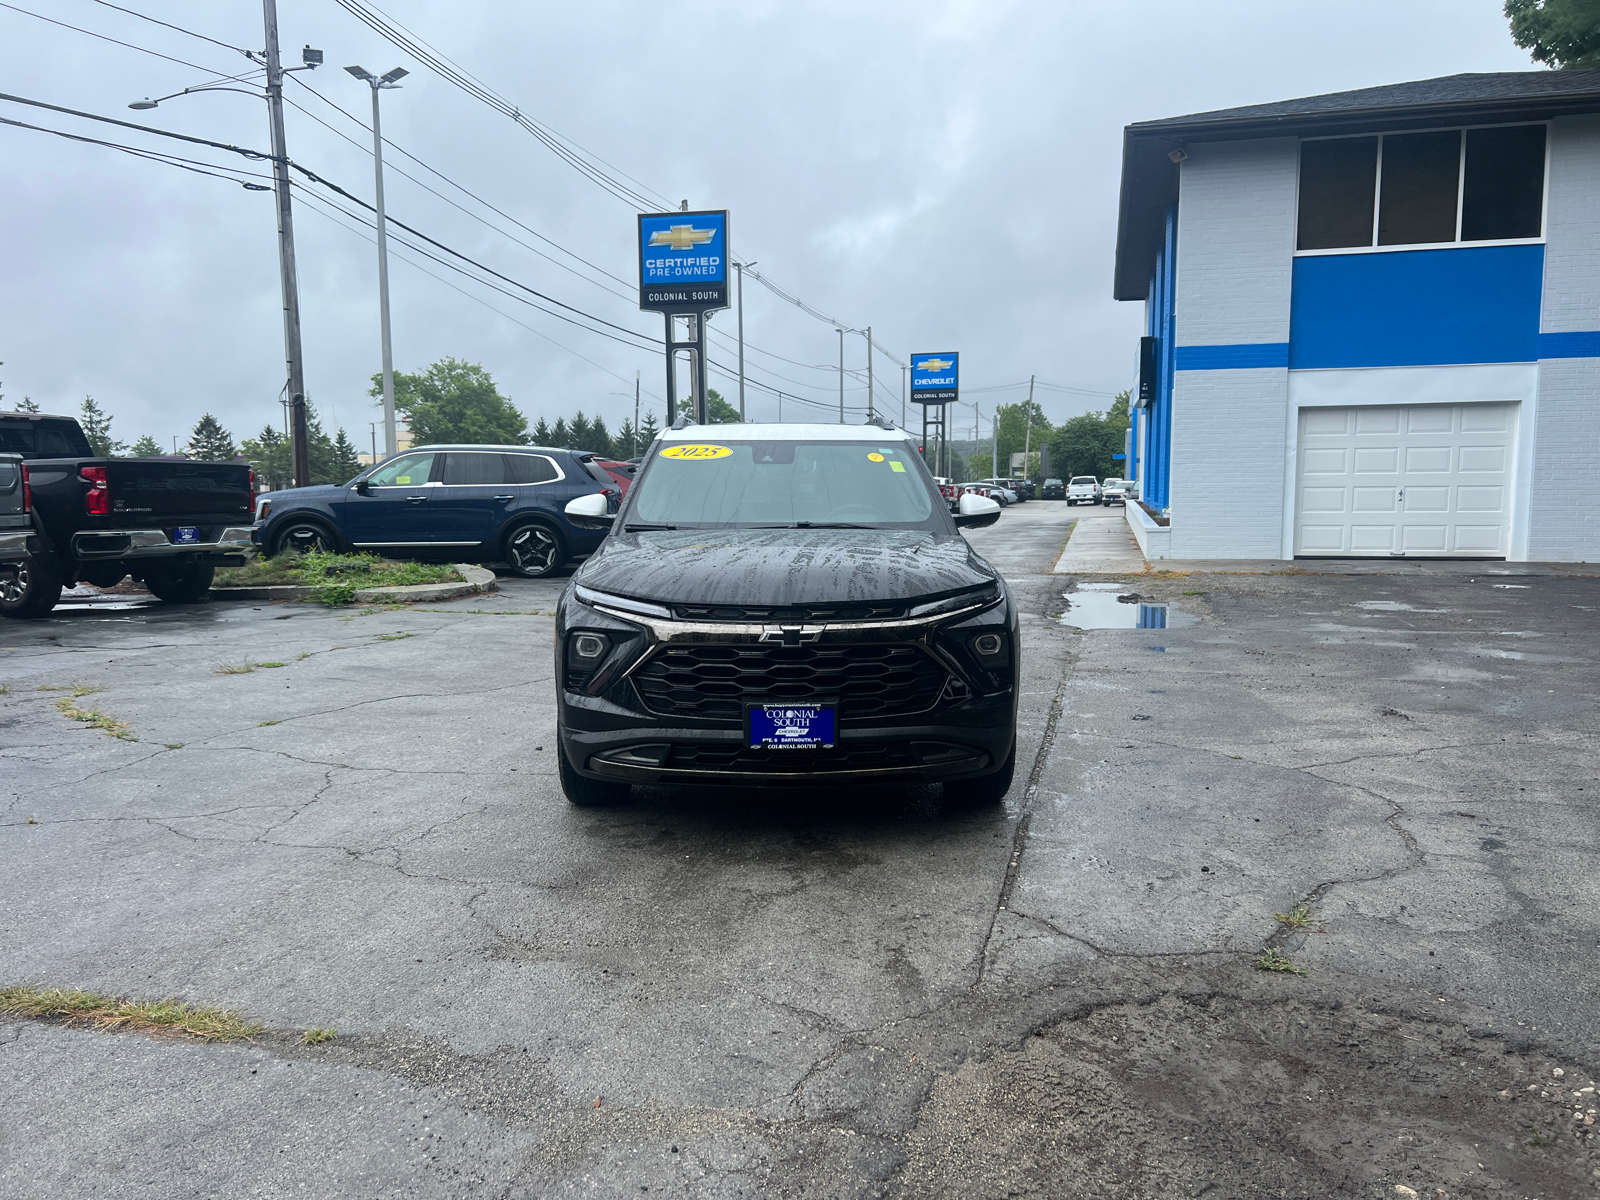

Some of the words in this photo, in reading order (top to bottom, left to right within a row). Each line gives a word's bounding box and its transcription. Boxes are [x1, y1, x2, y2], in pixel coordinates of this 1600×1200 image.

[646, 256, 720, 268] CERTIFIED
[650, 266, 716, 276] PRE-OWNED
[648, 292, 688, 302] COLONIAL
[692, 292, 718, 300] SOUTH
[670, 448, 722, 457] 2025
[766, 710, 818, 718] COLONIAL
